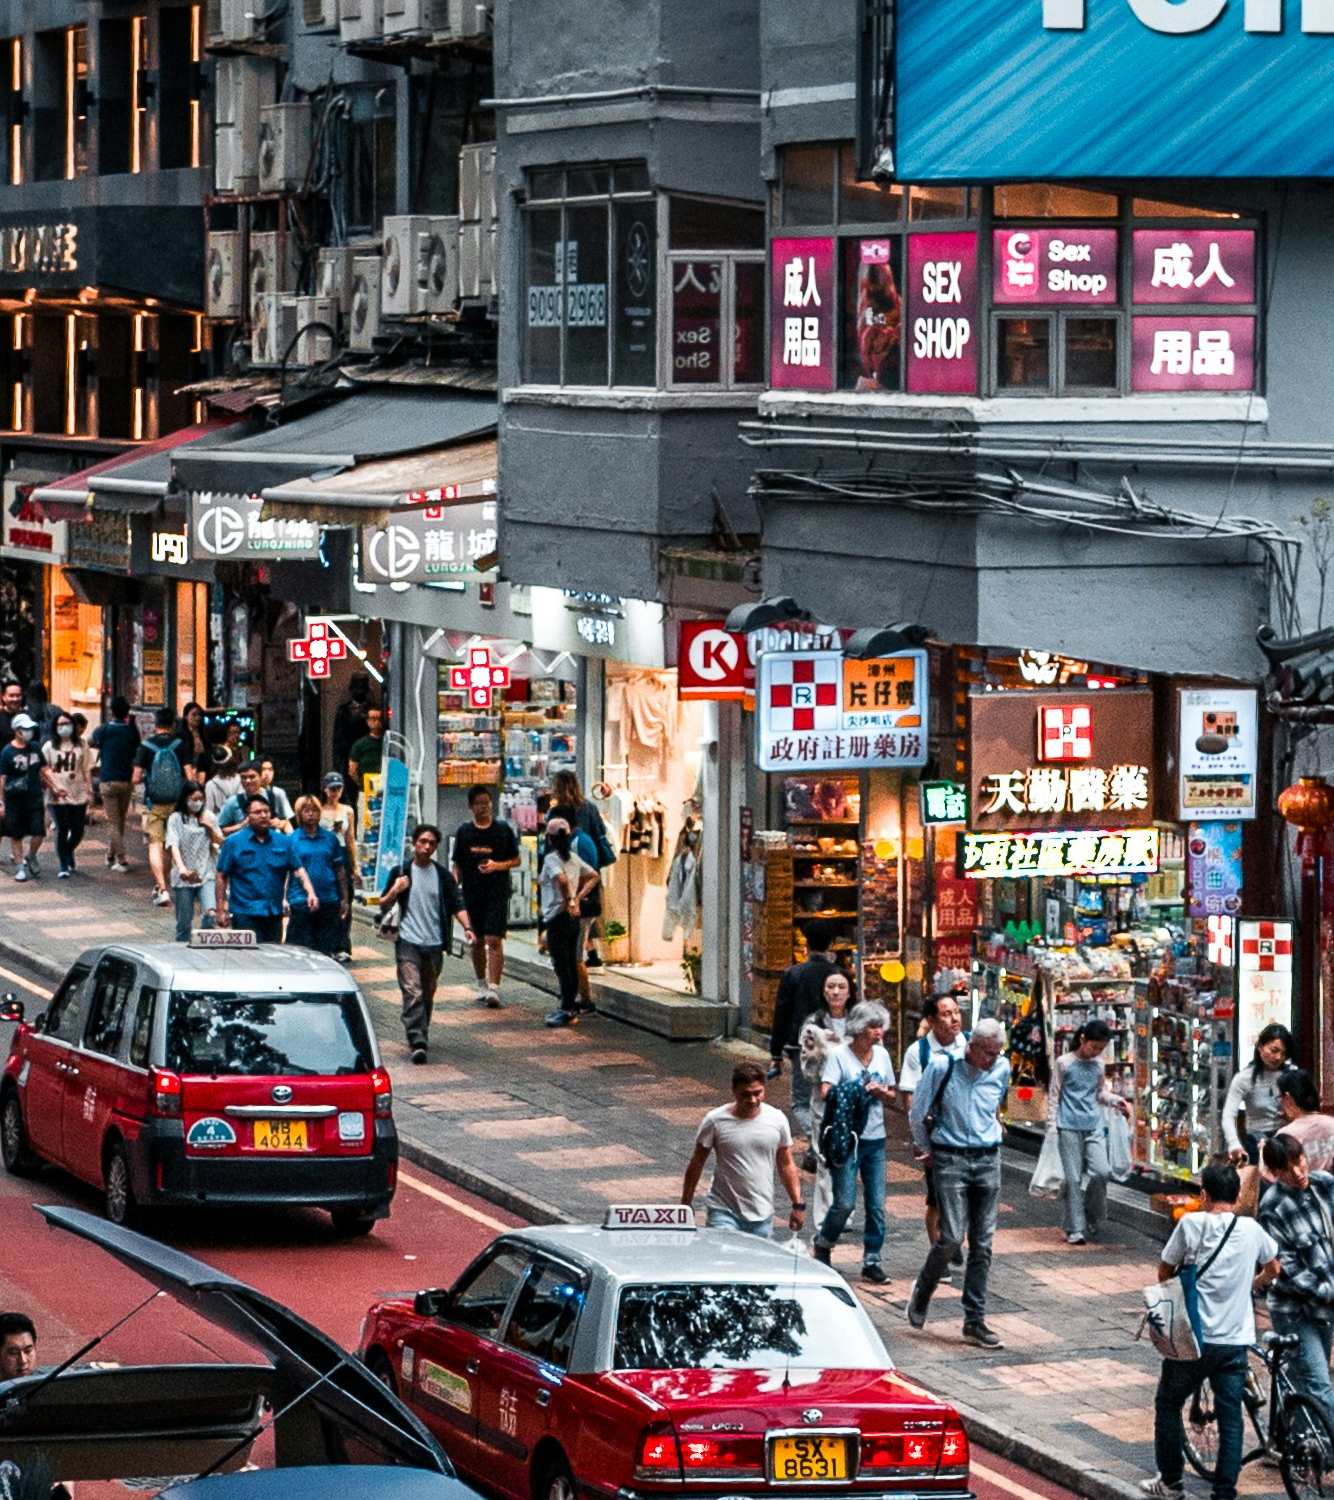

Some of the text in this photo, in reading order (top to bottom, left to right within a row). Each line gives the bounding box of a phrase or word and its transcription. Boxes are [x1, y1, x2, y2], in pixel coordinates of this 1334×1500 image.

[1047, 239, 1091, 265] Sex
[1151, 242, 1236, 291] 成人
[782, 256, 822, 309] 成人
[922, 261, 963, 305] SEX
[1047, 269, 1108, 296] Shop
[782, 316, 822, 368] 用品
[913, 317, 971, 361] SHOP
[1149, 329, 1236, 377] 用品
[150, 532, 189, 565] UPSO
[702, 639, 731, 669] K
[867, 663, 896, 678] 漳州
[986, 765, 1149, 814] 天勤醫藥
[938, 888, 973, 907] 成人
[938, 908, 974, 927] 用品
[195, 930, 255, 946] TAXI
[206, 1126, 215, 1135] 4
[269, 1119, 292, 1134] WB
[259, 1134, 305, 1149] 4044
[613, 1206, 691, 1226] TAXI
[793, 1437, 825, 1458] SX
[782, 1458, 839, 1479] 8631
